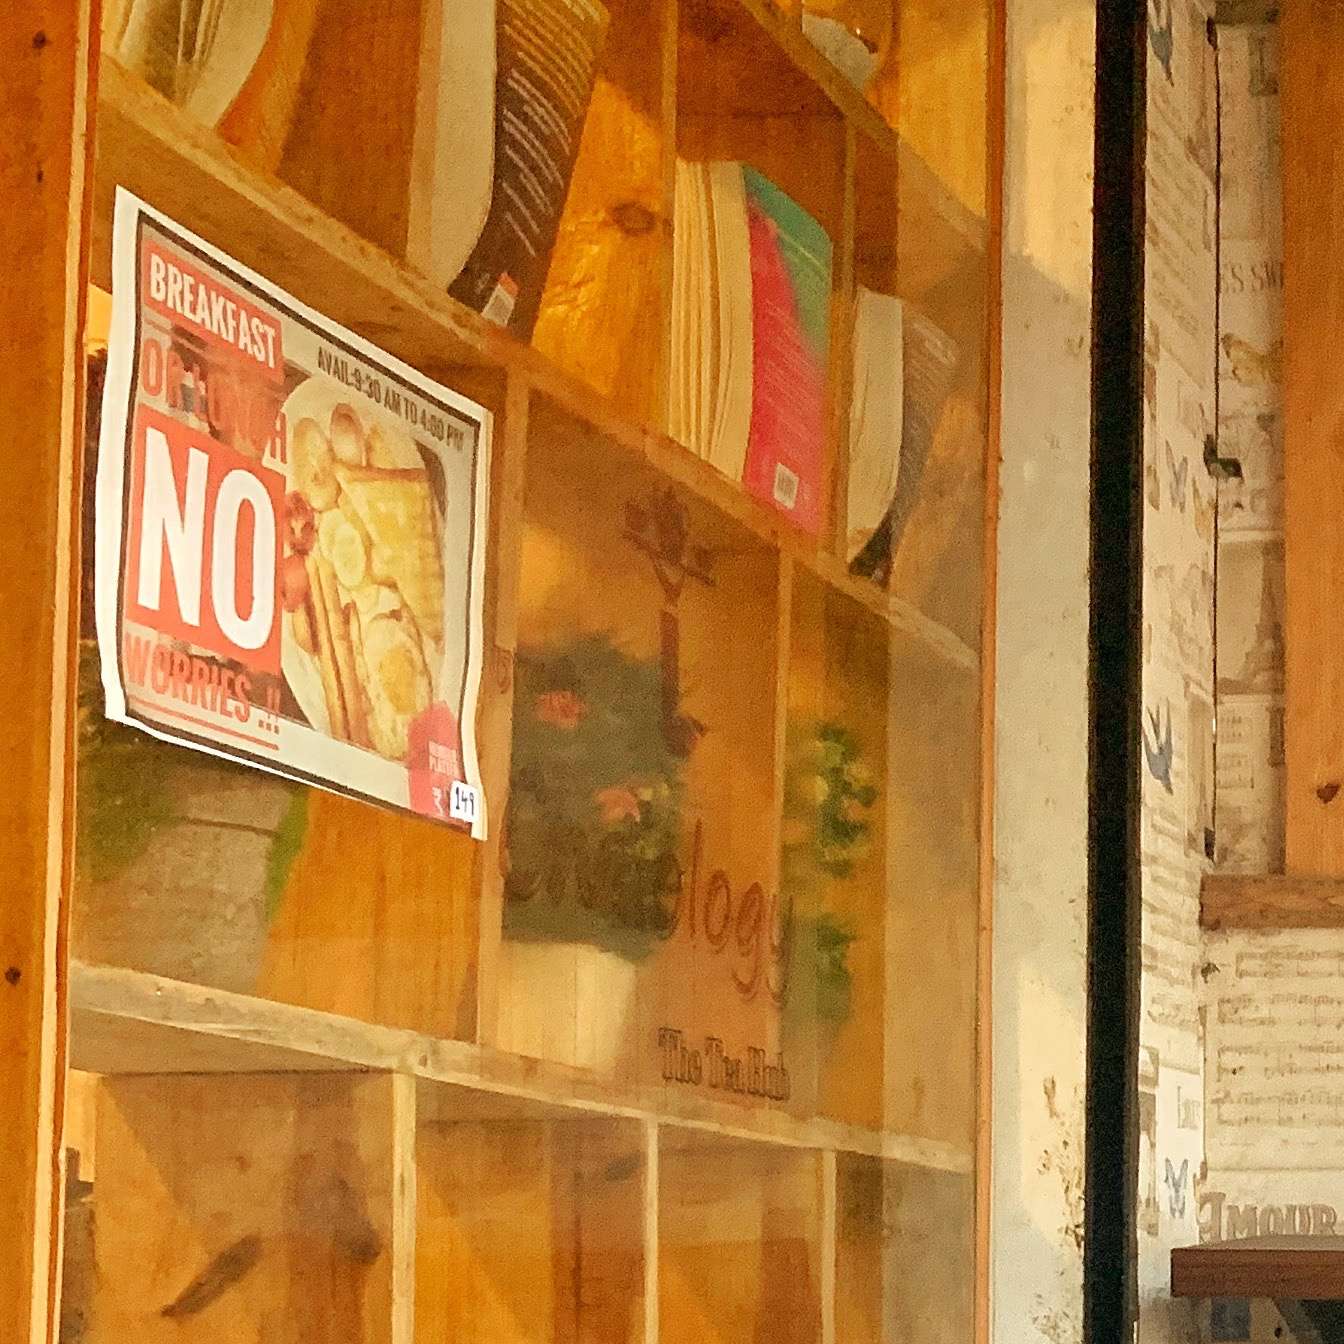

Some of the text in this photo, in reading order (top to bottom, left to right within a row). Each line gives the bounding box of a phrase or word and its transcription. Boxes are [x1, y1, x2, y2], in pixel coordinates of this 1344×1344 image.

[151, 253, 276, 368] BREAKFAST
[136, 427, 276, 652] NO
[124, 631, 251, 723] WORRIES
[455, 786, 475, 817] 149
